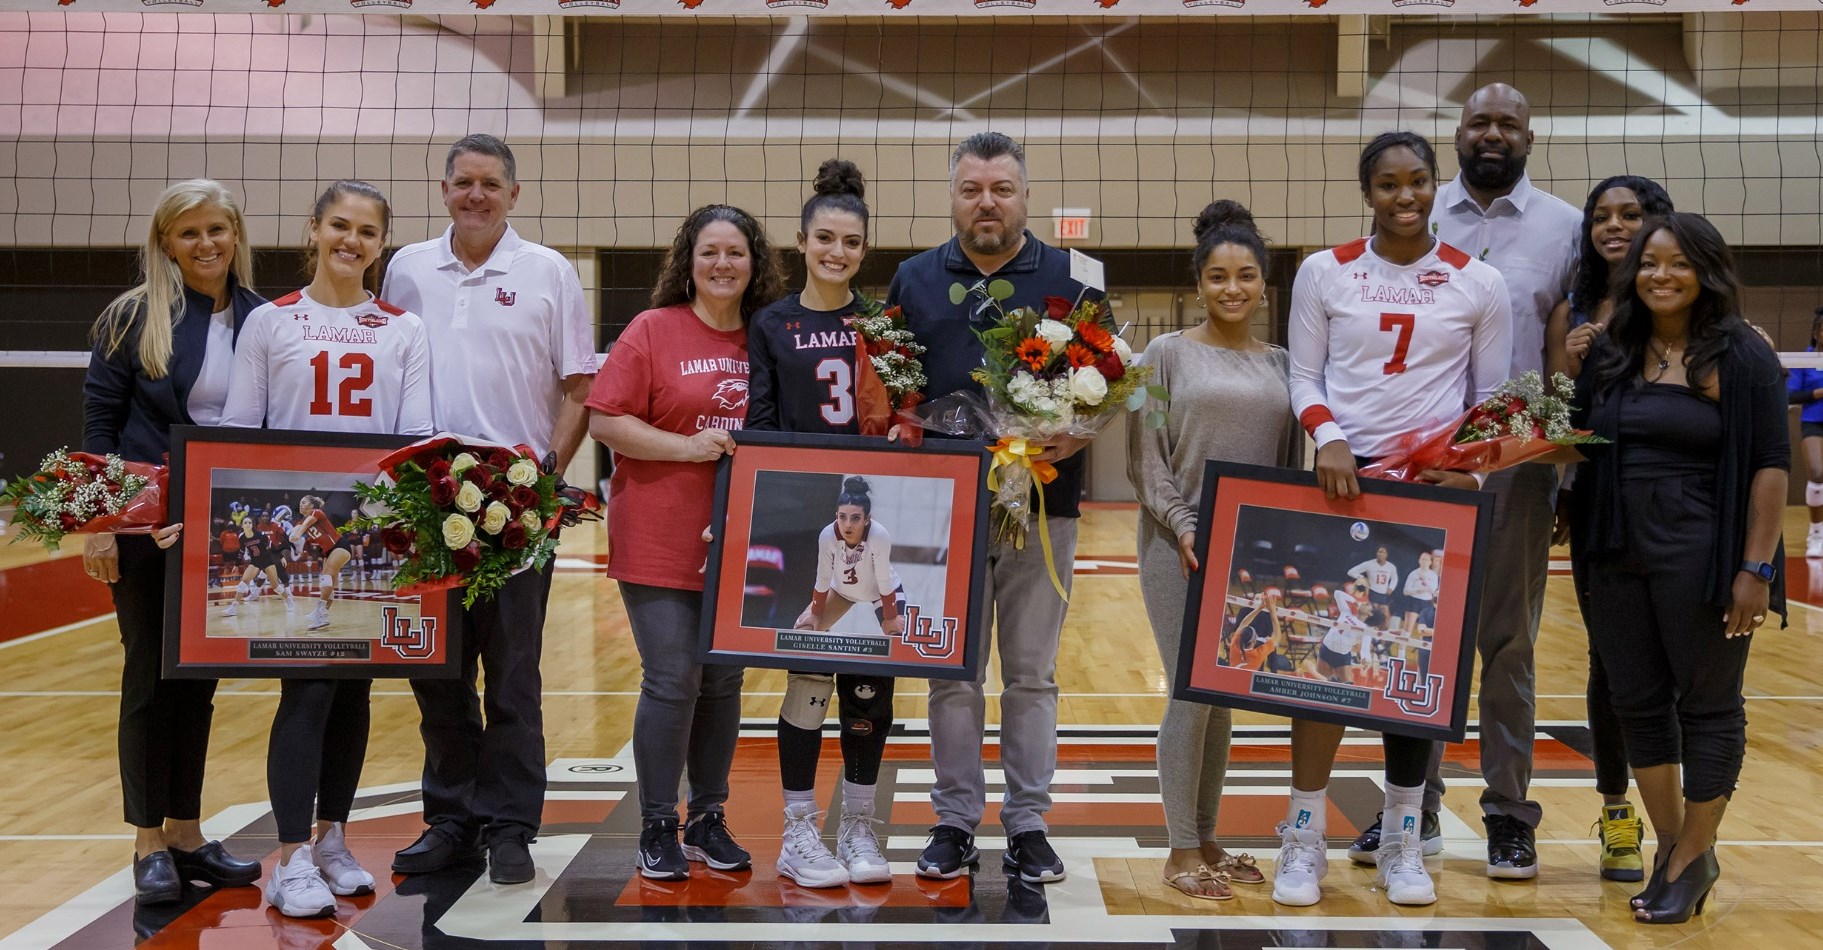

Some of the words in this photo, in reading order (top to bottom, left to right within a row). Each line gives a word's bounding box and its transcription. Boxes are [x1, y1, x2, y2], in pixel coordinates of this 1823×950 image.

[1059, 218, 1086, 237] EXIT
[495, 287, 516, 306] LU
[1361, 285, 1435, 305] LAMAR
[303, 325, 377, 344] LAMAR
[1379, 312, 1415, 375] 7
[680, 359, 718, 376] LAMAR
[310, 350, 374, 417] 12
[815, 357, 853, 426] 3
[842, 567, 858, 584] 3
[1376, 574, 1387, 585] 13
[381, 606, 436, 659] LU
[902, 604, 957, 658] LU
[804, 636, 844, 644] UNIVERSITY
[845, 638, 887, 646] VOLLEYBALL
[1256, 677, 1279, 685] LAMAR
[1281, 680, 1322, 691] UNIVERSITY
[1323, 687, 1367, 698] VOLLEYBALL
[1269, 687, 1297, 696] AMBER
[1299, 691, 1338, 702] JOHNSON
[1384, 657, 1444, 717] LU
